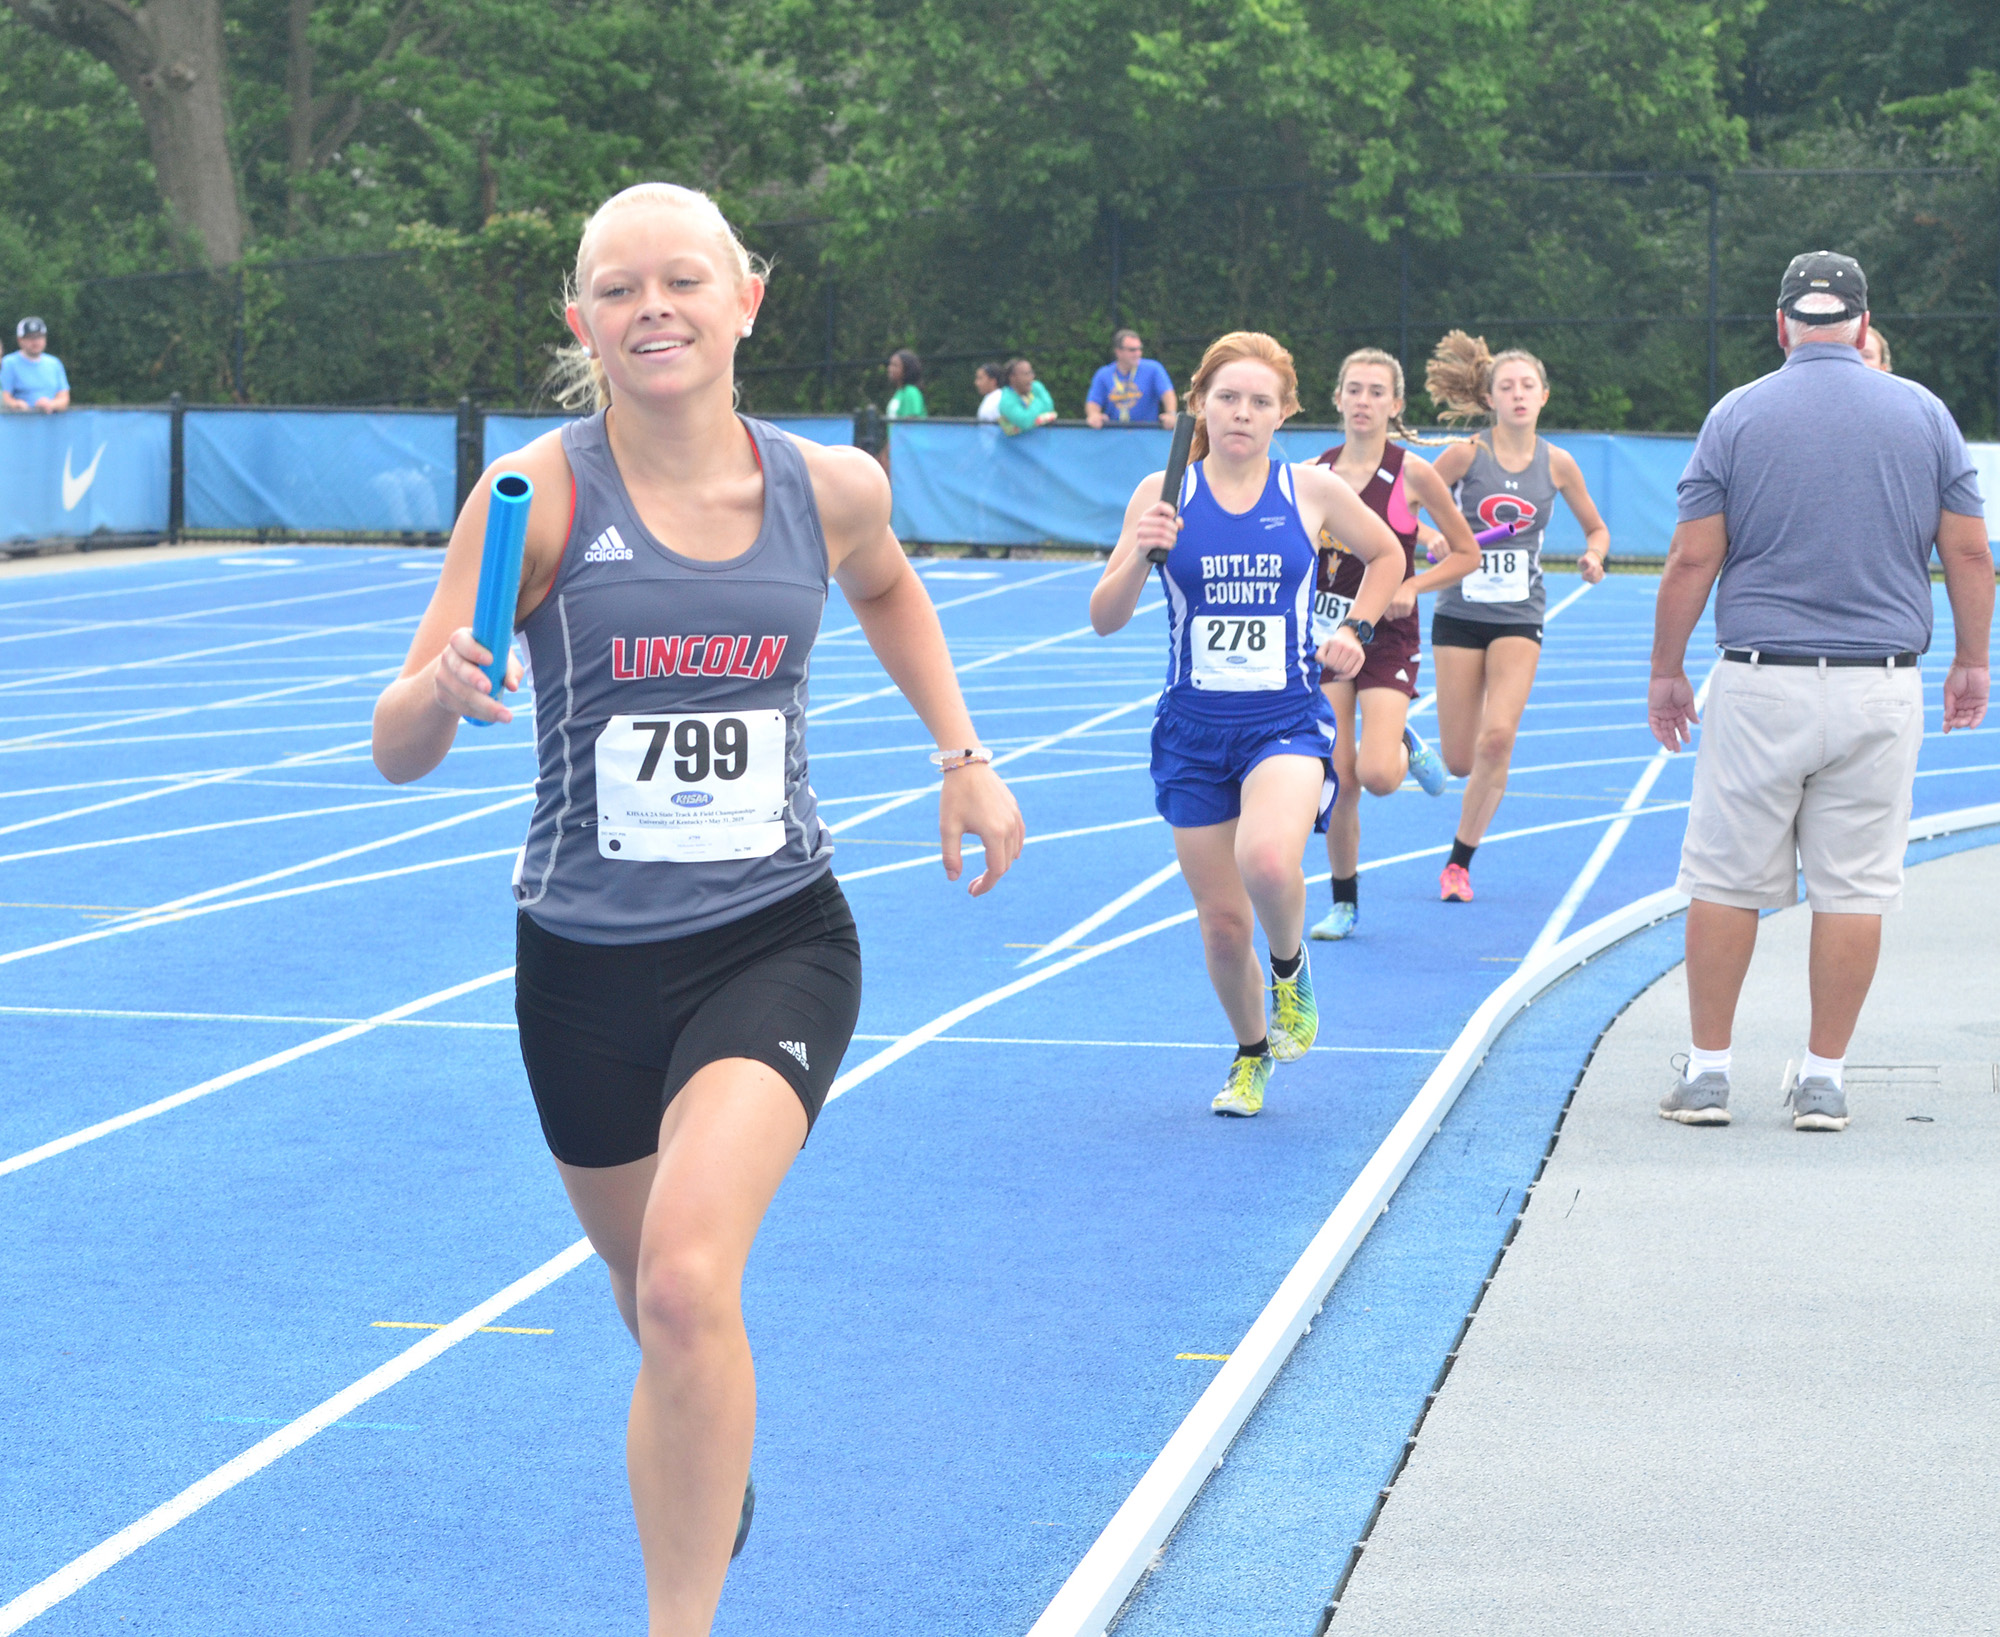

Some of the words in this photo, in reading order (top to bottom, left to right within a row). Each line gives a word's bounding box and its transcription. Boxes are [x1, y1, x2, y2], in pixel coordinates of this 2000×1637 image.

[1477, 493, 1537, 533] C
[584, 548, 634, 562] adidas
[1200, 554, 1283, 579] BUTLER
[1480, 552, 1515, 574] 418
[1204, 582, 1281, 604] COUNTY
[1207, 619, 1266, 651] 278
[612, 635, 788, 681] LINCOLN
[632, 718, 748, 782] 799
[676, 793, 709, 805] KHSAA
[715, 808, 756, 816] Championships
[778, 1040, 810, 1071] adidas
